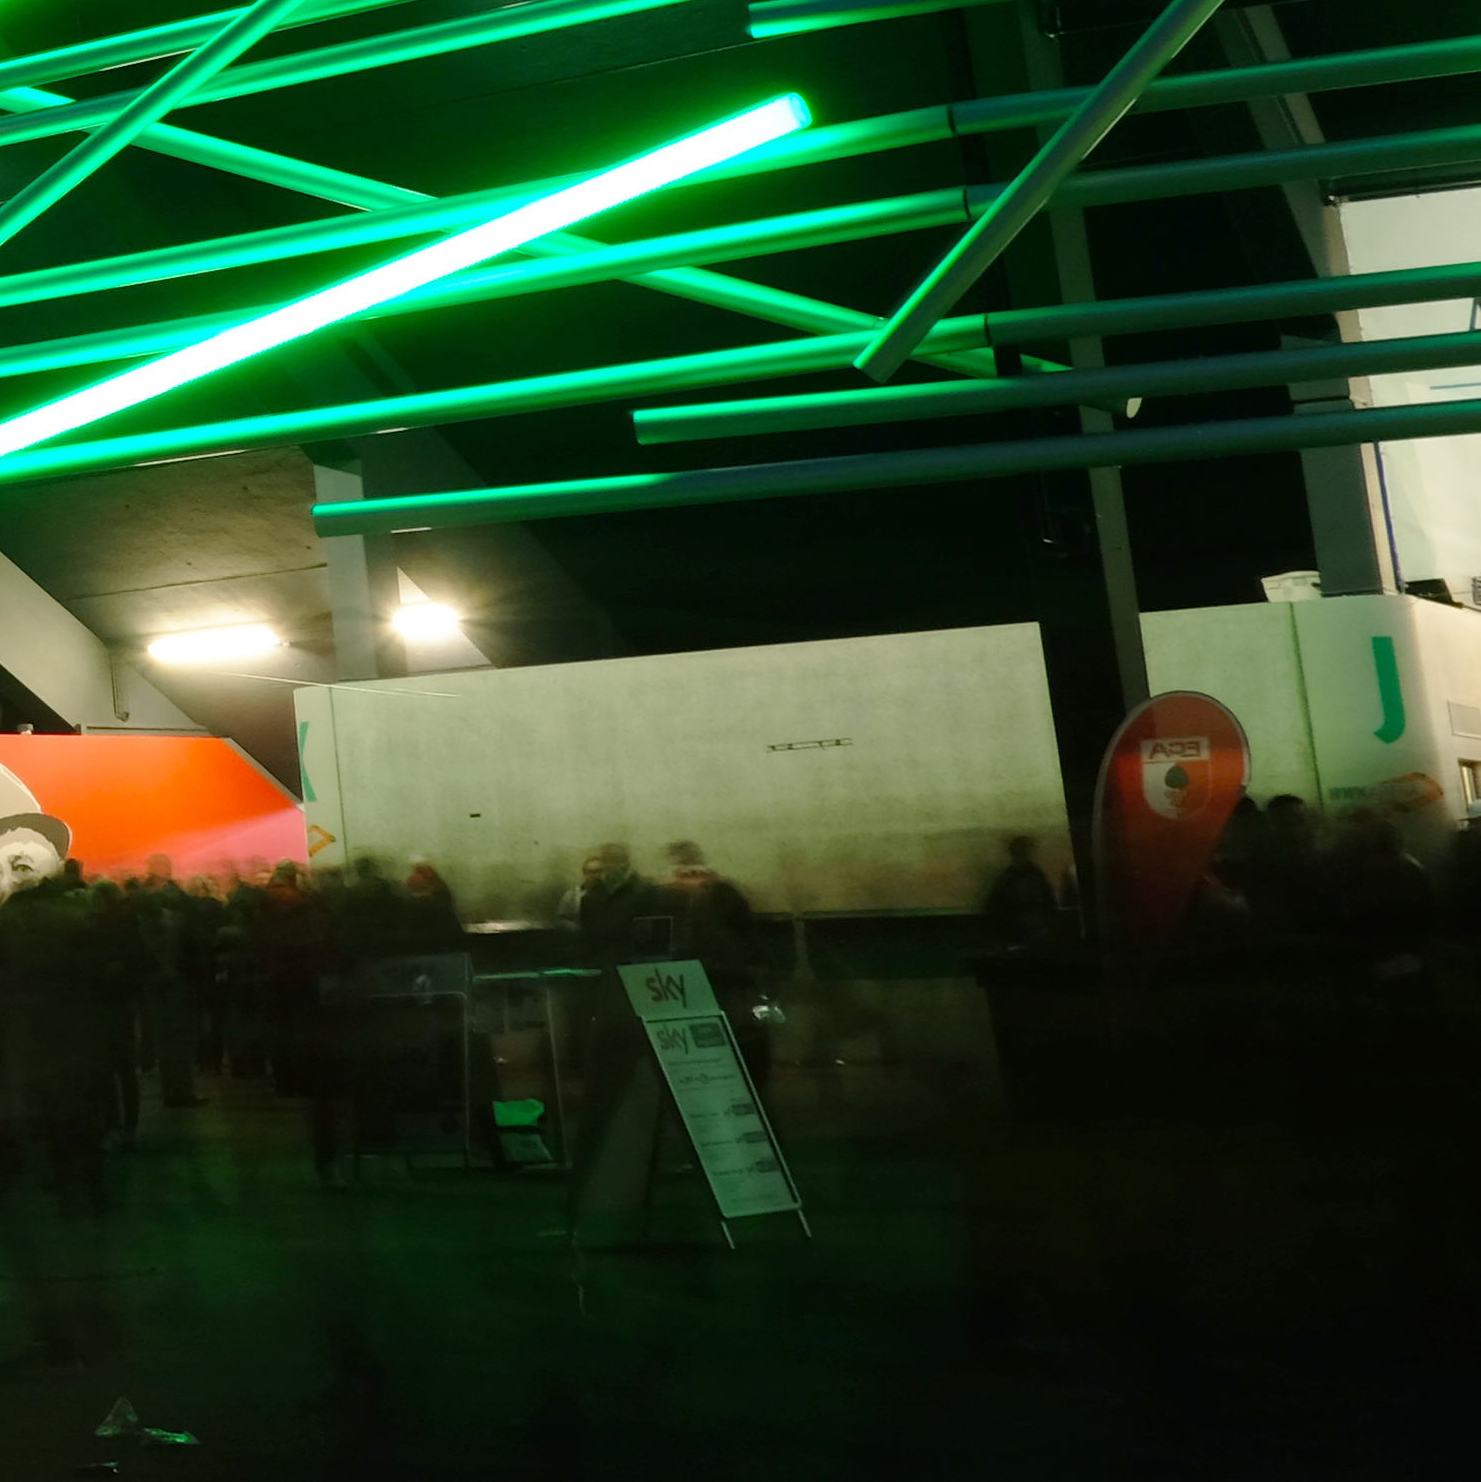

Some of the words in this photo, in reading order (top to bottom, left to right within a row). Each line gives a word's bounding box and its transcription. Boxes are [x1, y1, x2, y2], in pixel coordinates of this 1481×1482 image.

[1371, 635, 1406, 744] J
[645, 967, 687, 1009] sky
[656, 1023, 690, 1055] sky
